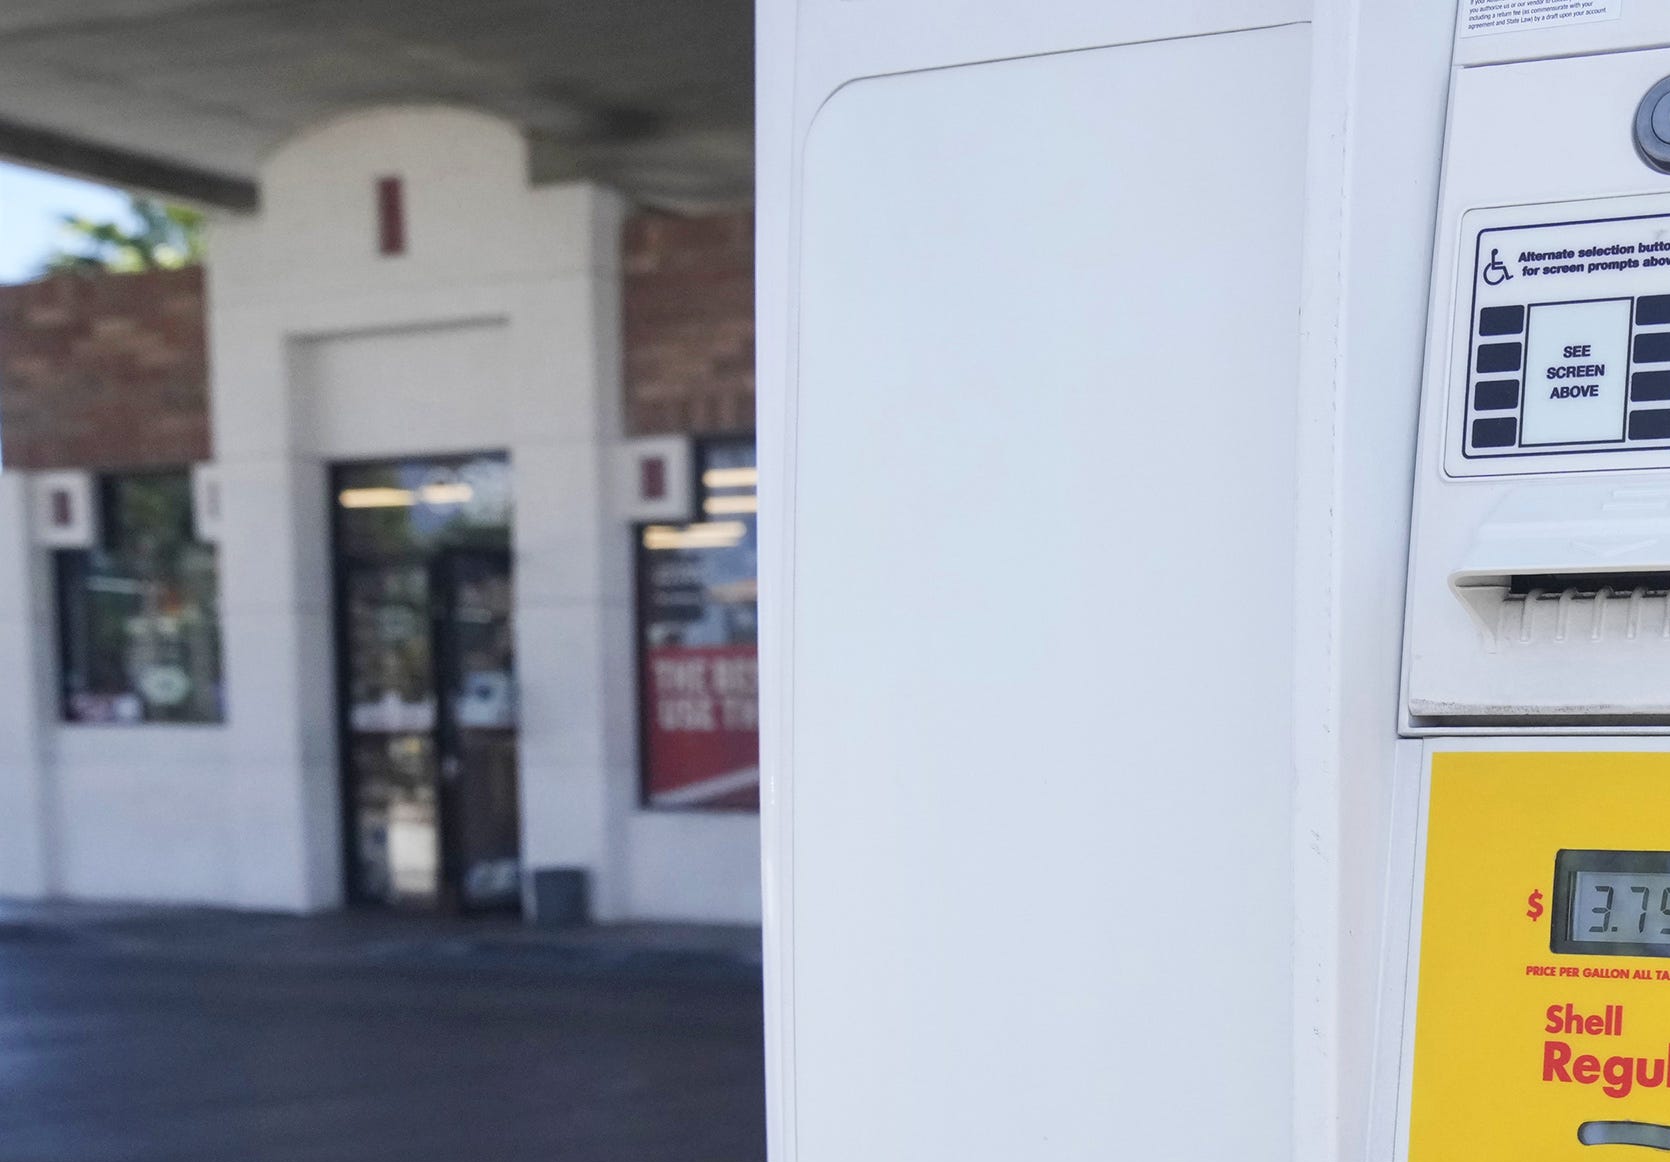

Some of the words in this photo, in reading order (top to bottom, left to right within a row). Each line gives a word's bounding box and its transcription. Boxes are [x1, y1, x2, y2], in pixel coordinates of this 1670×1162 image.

[1469, 13, 1492, 21] including
[1531, 4, 1568, 14] commensurate
[1479, 4, 1503, 12] authorize
[1468, 21, 1495, 30] agreement
[1573, 10, 1585, 18] your
[1518, 249, 1575, 263] Alternate
[1578, 244, 1634, 258] selection
[1522, 264, 1540, 277] for
[1542, 262, 1585, 275] screen
[1587, 258, 1640, 274] prompts
[1563, 345, 1591, 358] SEE
[1546, 364, 1605, 380] SCREEN
[1550, 385, 1600, 400] ABOVE
[1526, 889, 1544, 922] $
[1526, 965, 1556, 977] PRICE
[1559, 966, 1580, 978] PER
[1582, 967, 1630, 979] GALLON
[1632, 969, 1652, 980] ALL
[1544, 1003, 1623, 1037] Shell
